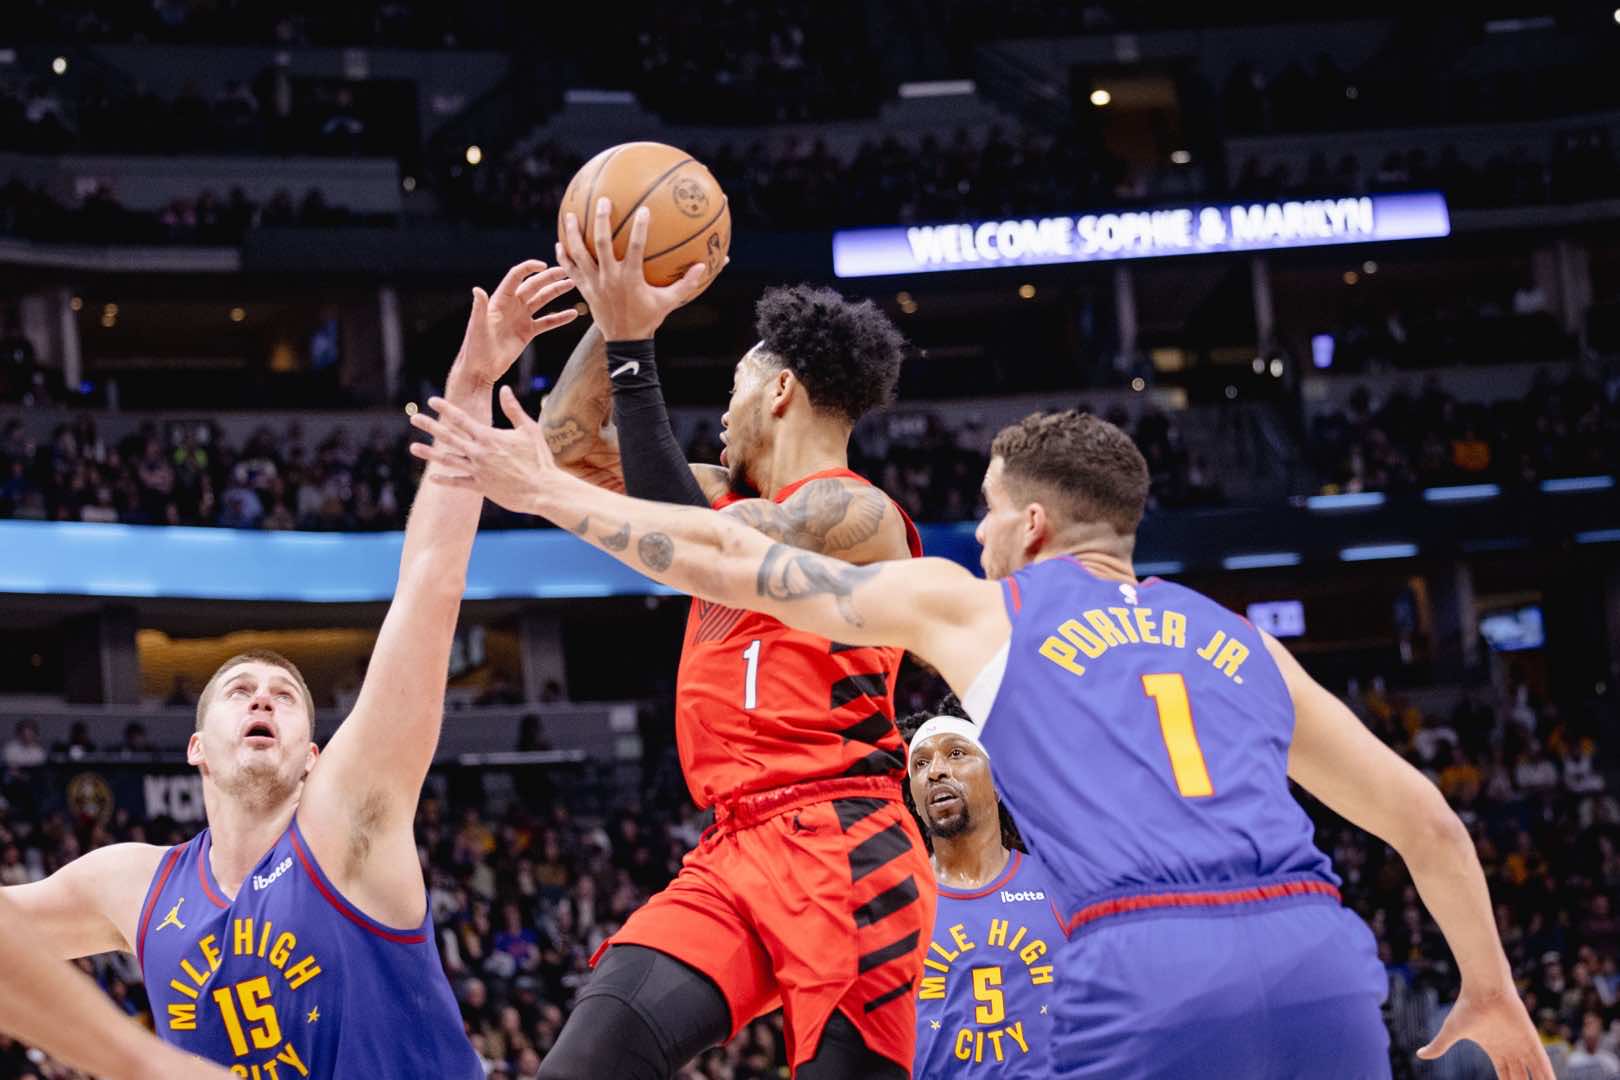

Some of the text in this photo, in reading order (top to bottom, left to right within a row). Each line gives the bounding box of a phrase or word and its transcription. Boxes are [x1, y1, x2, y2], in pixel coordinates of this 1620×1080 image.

[907, 196, 1374, 265] WELCOME SOPHIE & MARILYN
[742, 639, 761, 710] 1
[1038, 606, 1250, 685] PORTER JR.
[1140, 672, 1216, 798] 1
[252, 856, 294, 891] ibotta
[1000, 890, 1046, 904] ibotta
[167, 917, 323, 1031] MILE HIGH
[918, 918, 1054, 1000] MILE HIGH
[212, 975, 283, 1058] 15
[971, 965, 1006, 1025] 5
[954, 1021, 1030, 1063] CITY
